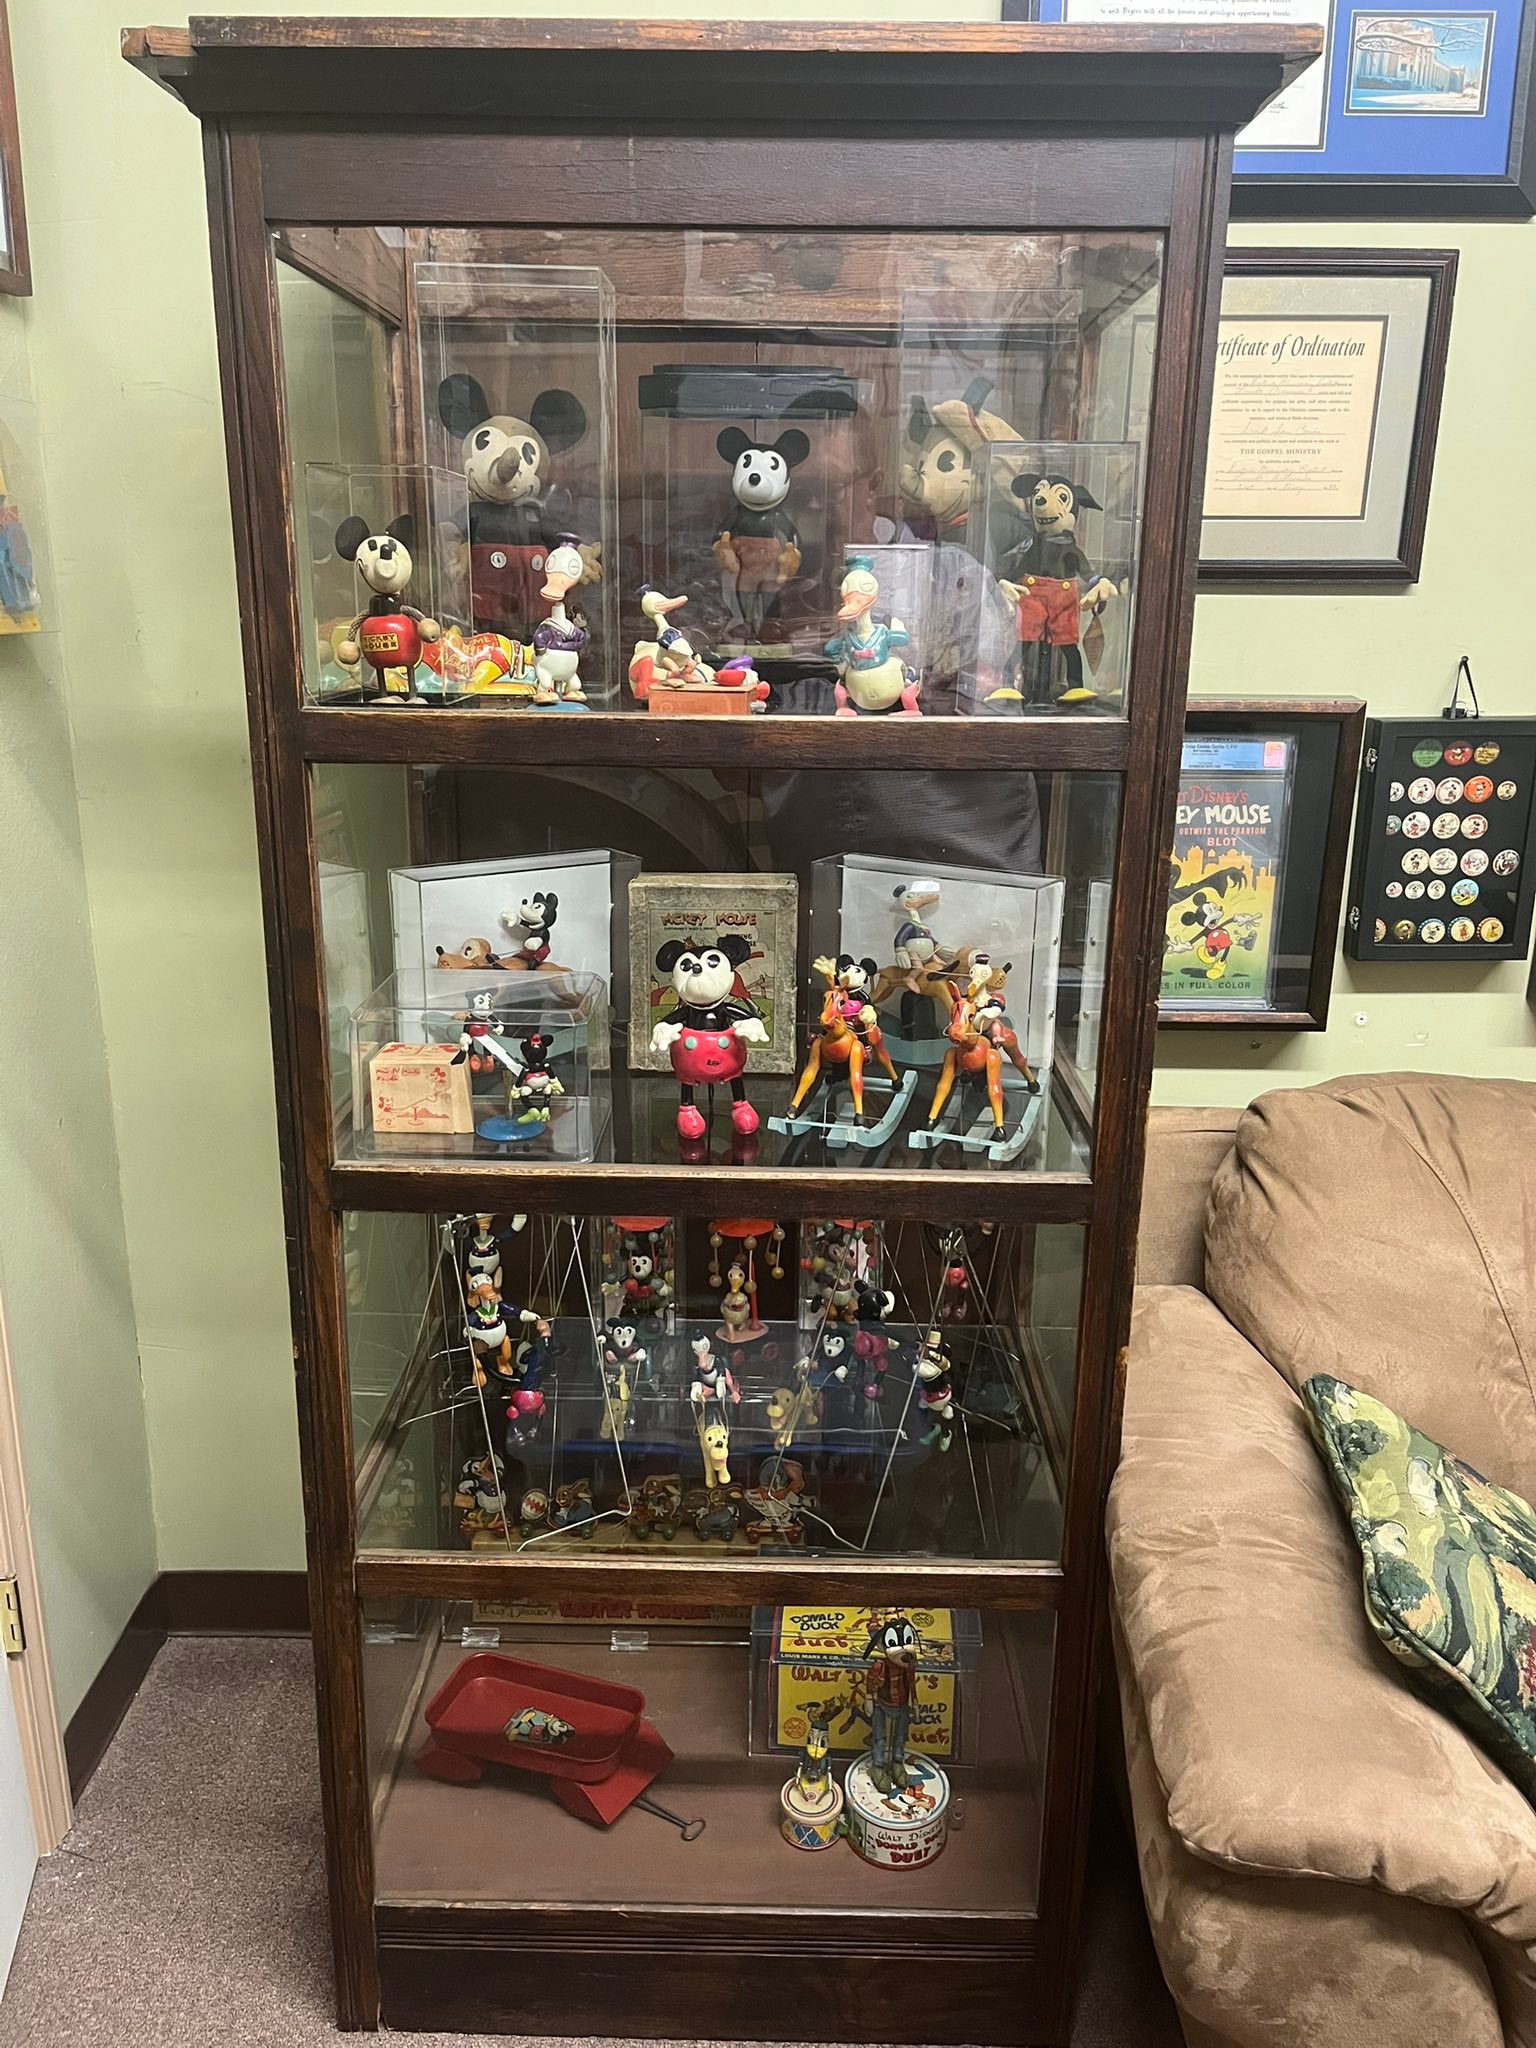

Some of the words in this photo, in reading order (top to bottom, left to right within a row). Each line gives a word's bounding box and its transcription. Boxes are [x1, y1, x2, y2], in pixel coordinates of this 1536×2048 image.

[1217, 334, 1269, 365] rtificate
[1272, 334, 1293, 365] of
[1291, 334, 1366, 357] Ordination
[1286, 448, 1322, 456] MINISTRY
[1177, 791, 1189, 804] LT
[1204, 804, 1272, 825] MOUSE
[1179, 827, 1212, 836] OUTWITS
[1214, 827, 1229, 836] THE
[1231, 827, 1266, 836] PHANTOM
[1207, 837, 1238, 847] BLOT
[661, 912, 708, 926] MICKEY
[715, 912, 757, 926] MOUSE
[1174, 981, 1185, 989] IN
[1189, 981, 1213, 989] FULL
[1218, 981, 1251, 989] COLOR
[789, 1612, 846, 1624] DONALD
[800, 1621, 841, 1632] DUCK
[793, 1635, 850, 1649] duet
[791, 1665, 842, 1683] WALT
[911, 1728, 949, 1745] uet
[877, 1831, 903, 1842] WALT
[890, 1846, 931, 1863] DUET
